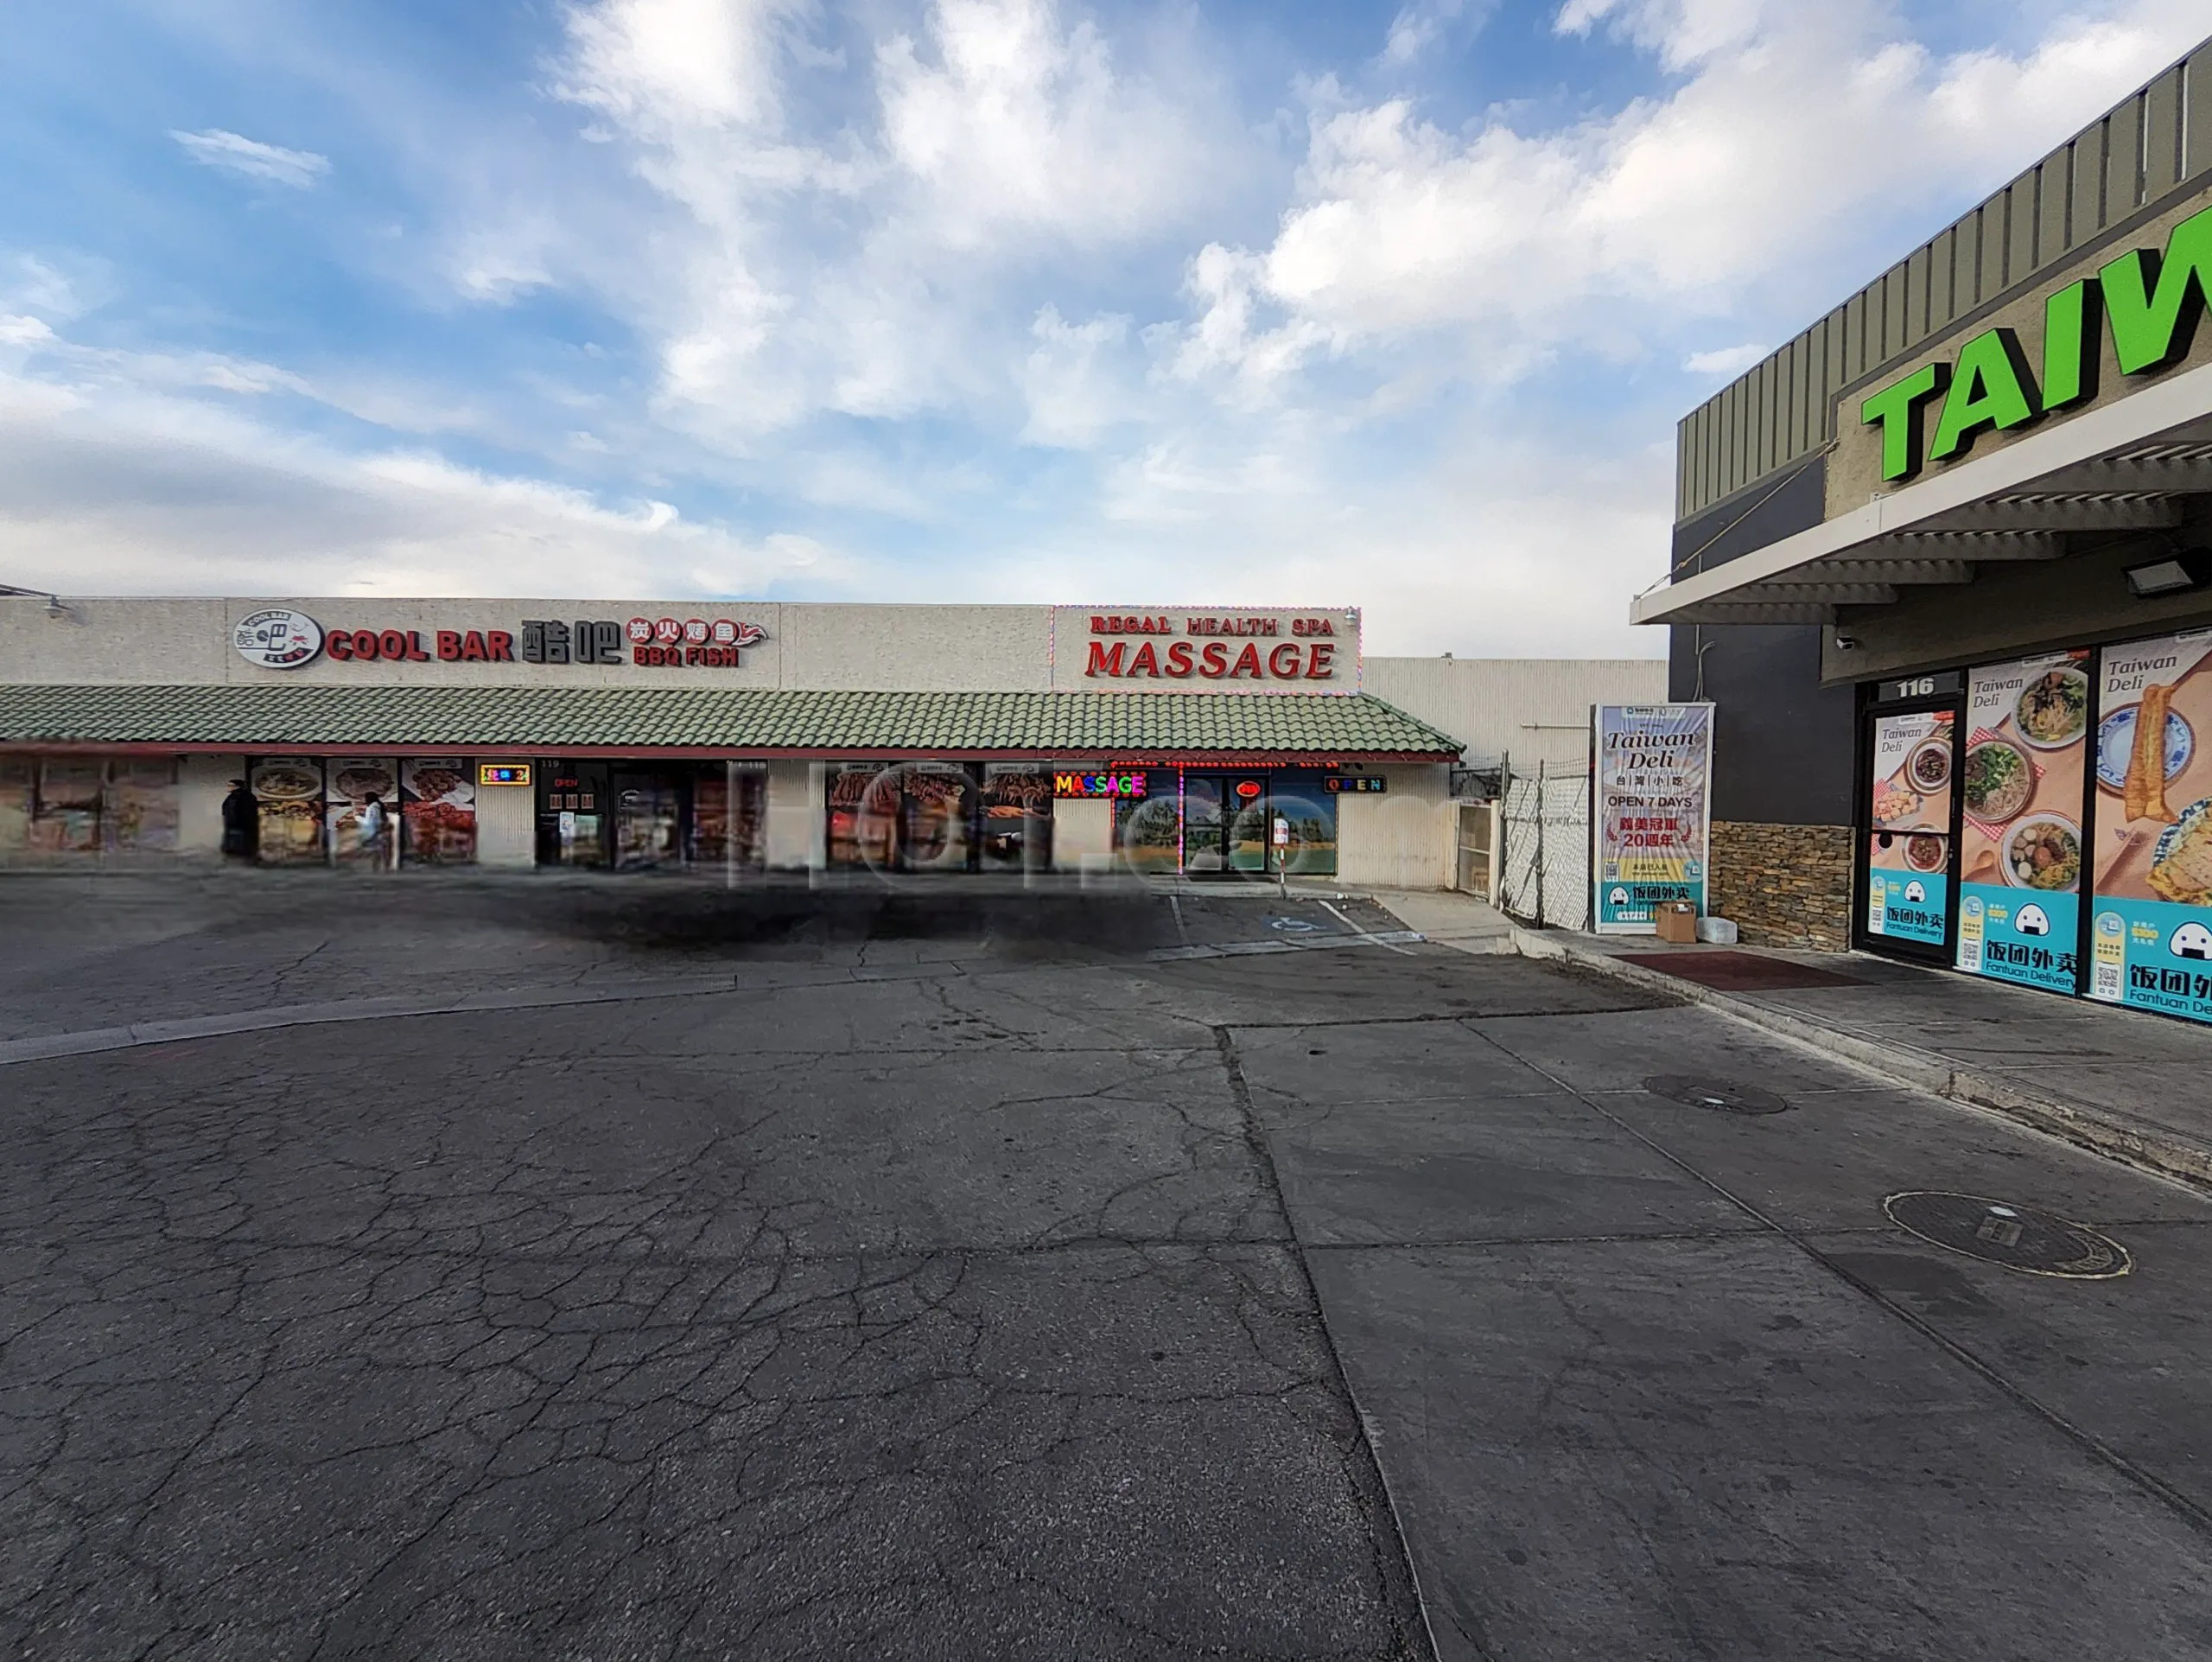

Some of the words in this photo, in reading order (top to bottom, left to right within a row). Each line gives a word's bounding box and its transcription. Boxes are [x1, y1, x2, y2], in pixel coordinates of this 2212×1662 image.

[247, 614, 270, 626] COOL
[1090, 615, 1172, 634] REGAL
[1186, 617, 1278, 636] HEALTH
[1292, 618, 1335, 636] SPA
[326, 629, 429, 662] COOL
[436, 629, 514, 662] BAR
[521, 619, 622, 665] 酷吧
[633, 646, 682, 666] BBQ
[686, 646, 739, 667] FISH
[1084, 641, 1336, 679] MASSAGE
[2108, 655, 2177, 676] Taiwan
[1897, 677, 1935, 697] 116
[1974, 676, 2024, 694] Taiwan
[2107, 674, 2144, 692] Deli
[1974, 694, 1999, 708] Deli
[1608, 730, 1694, 748] Taiwan
[1882, 726, 1922, 739] Taiwan
[1881, 740, 1903, 752] Deli
[1628, 750, 1675, 769] Deli
[554, 779, 577, 787] OPEN
[1056, 776, 1144, 793] MASSAGE
[1328, 779, 1381, 790] OPEN
[1608, 796, 1643, 806] OPEN
[1648, 797, 1655, 806] 7
[1658, 797, 1692, 807] DAYS
[1986, 961, 2027, 978] Fantuan
[2130, 989, 2188, 1009] Fantuan
